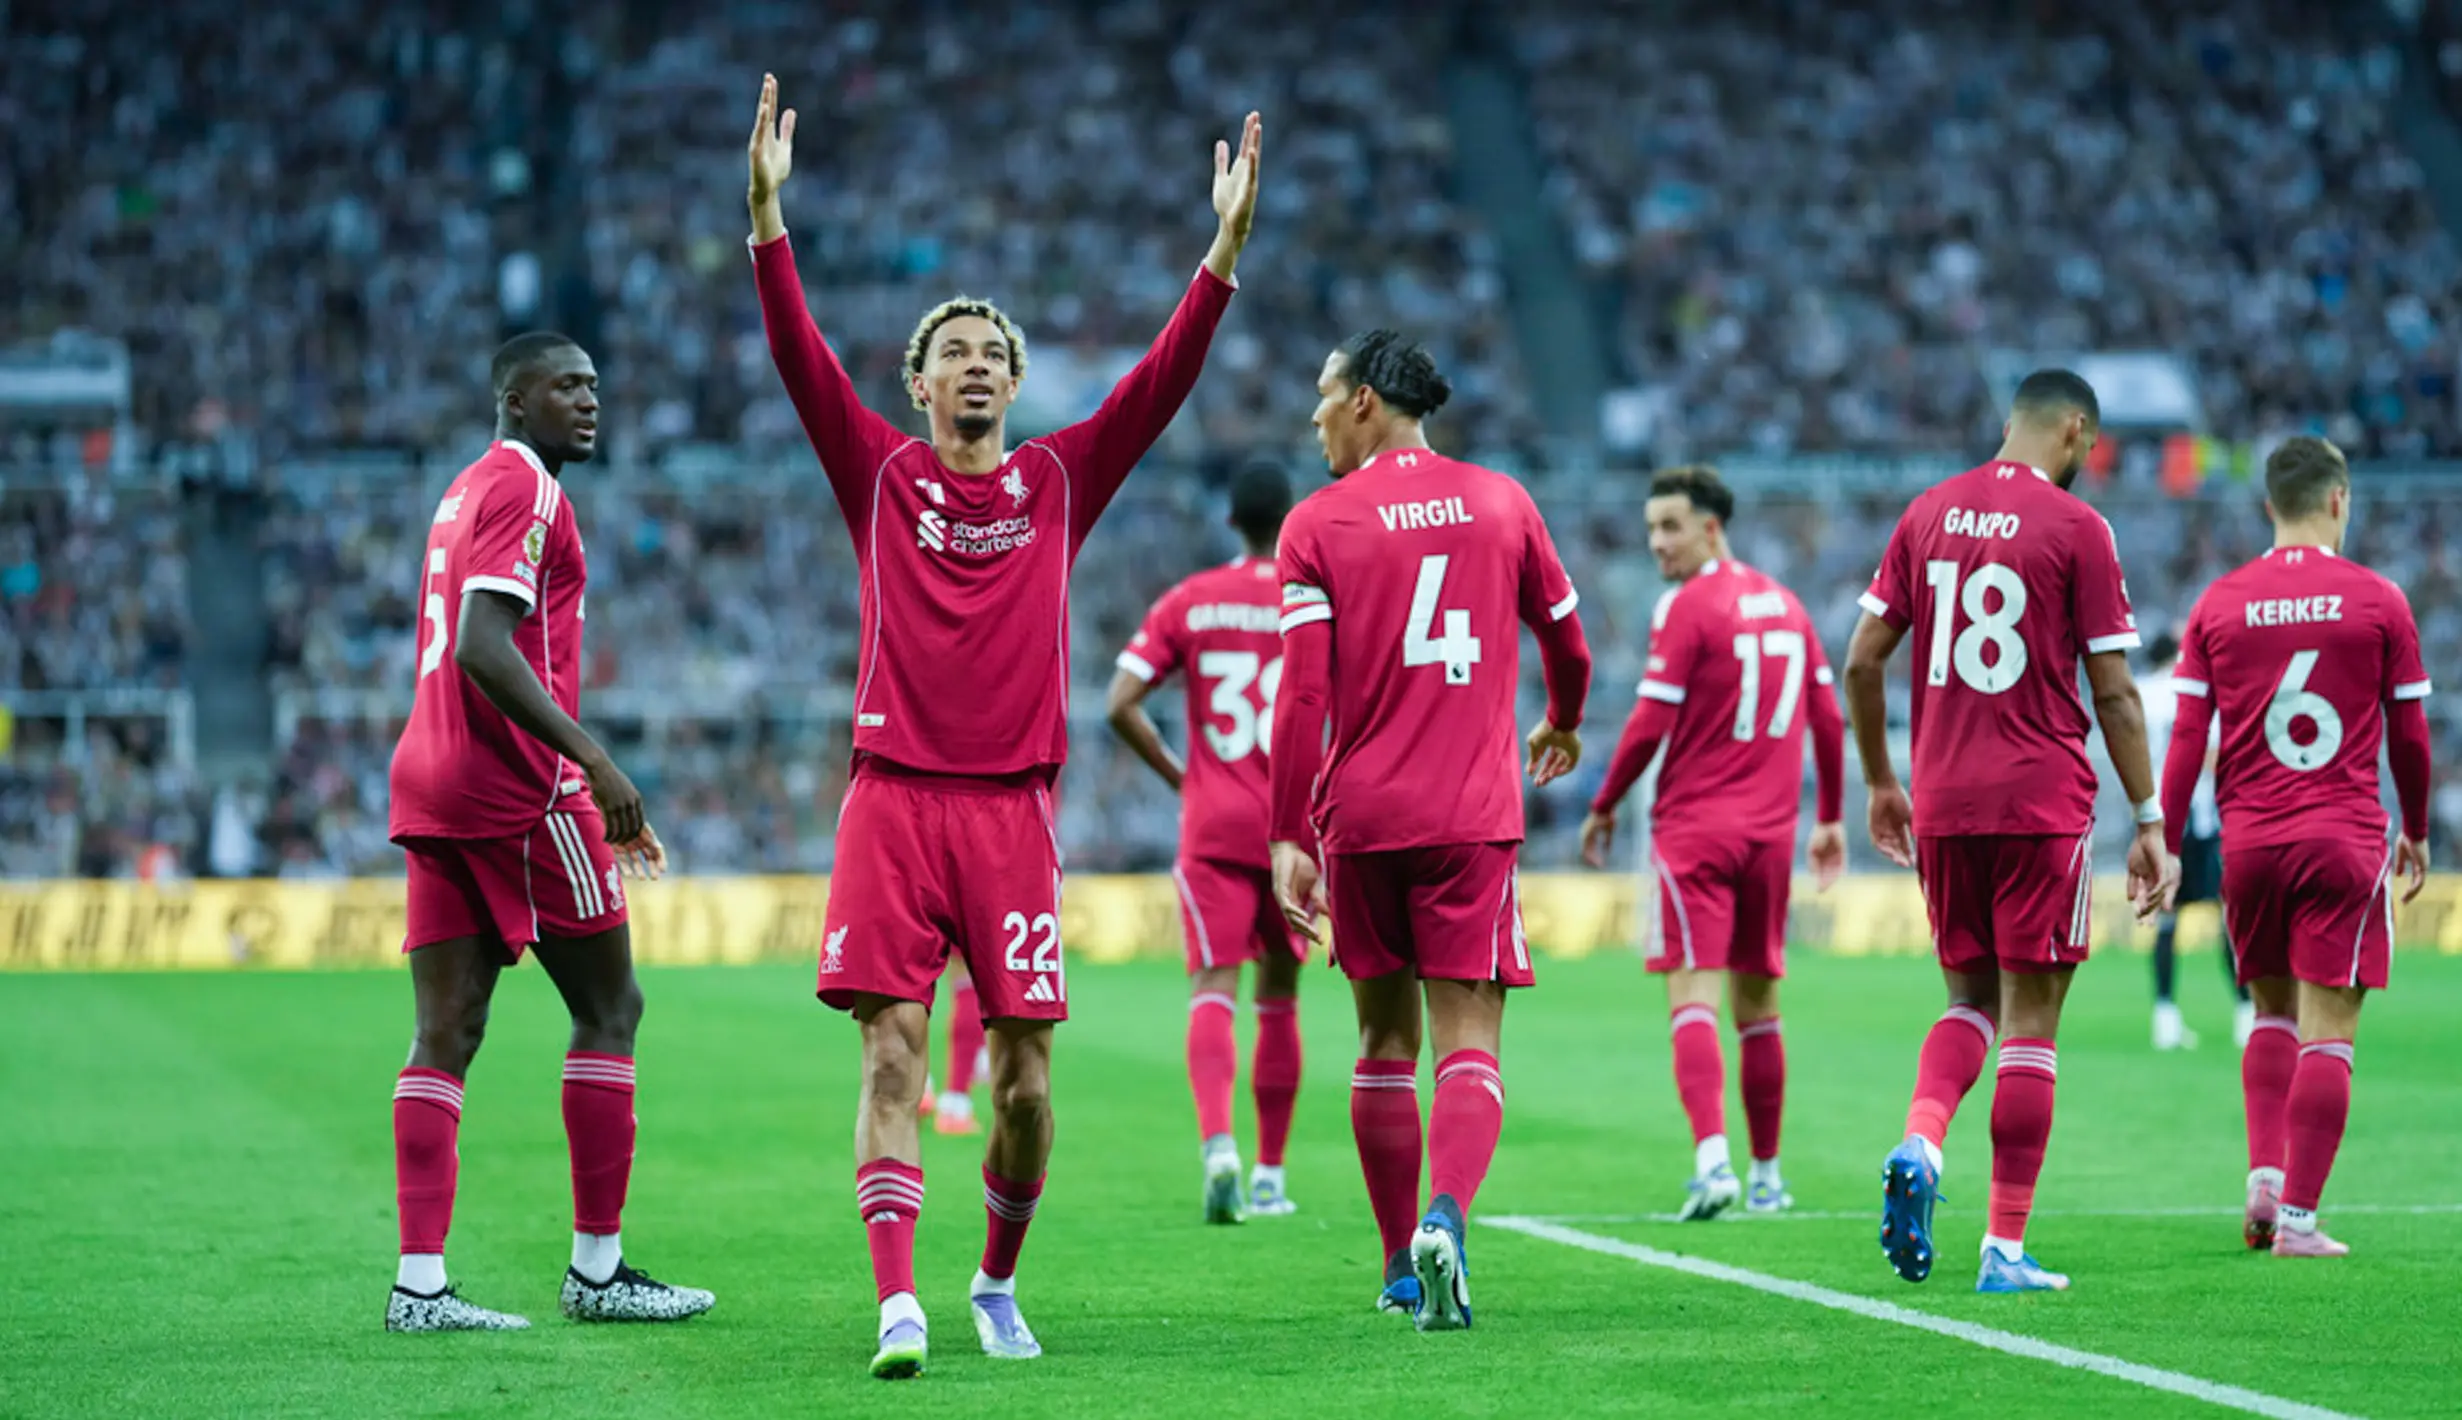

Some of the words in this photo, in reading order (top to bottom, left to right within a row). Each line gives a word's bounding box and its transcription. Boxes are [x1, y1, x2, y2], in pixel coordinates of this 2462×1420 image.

[950, 527, 1036, 555] chartered
[951, 513, 1030, 540] standard
[1377, 496, 1475, 532] VIRGIL
[1943, 506, 2021, 540] GAKPO
[421, 547, 449, 681] 5
[1403, 554, 1482, 685] 4
[1926, 559, 2028, 695] 18
[2245, 595, 2343, 628] KERKEZ
[1733, 630, 1806, 742] 17
[2264, 649, 2343, 772] 6
[1003, 910, 1058, 973] 22
